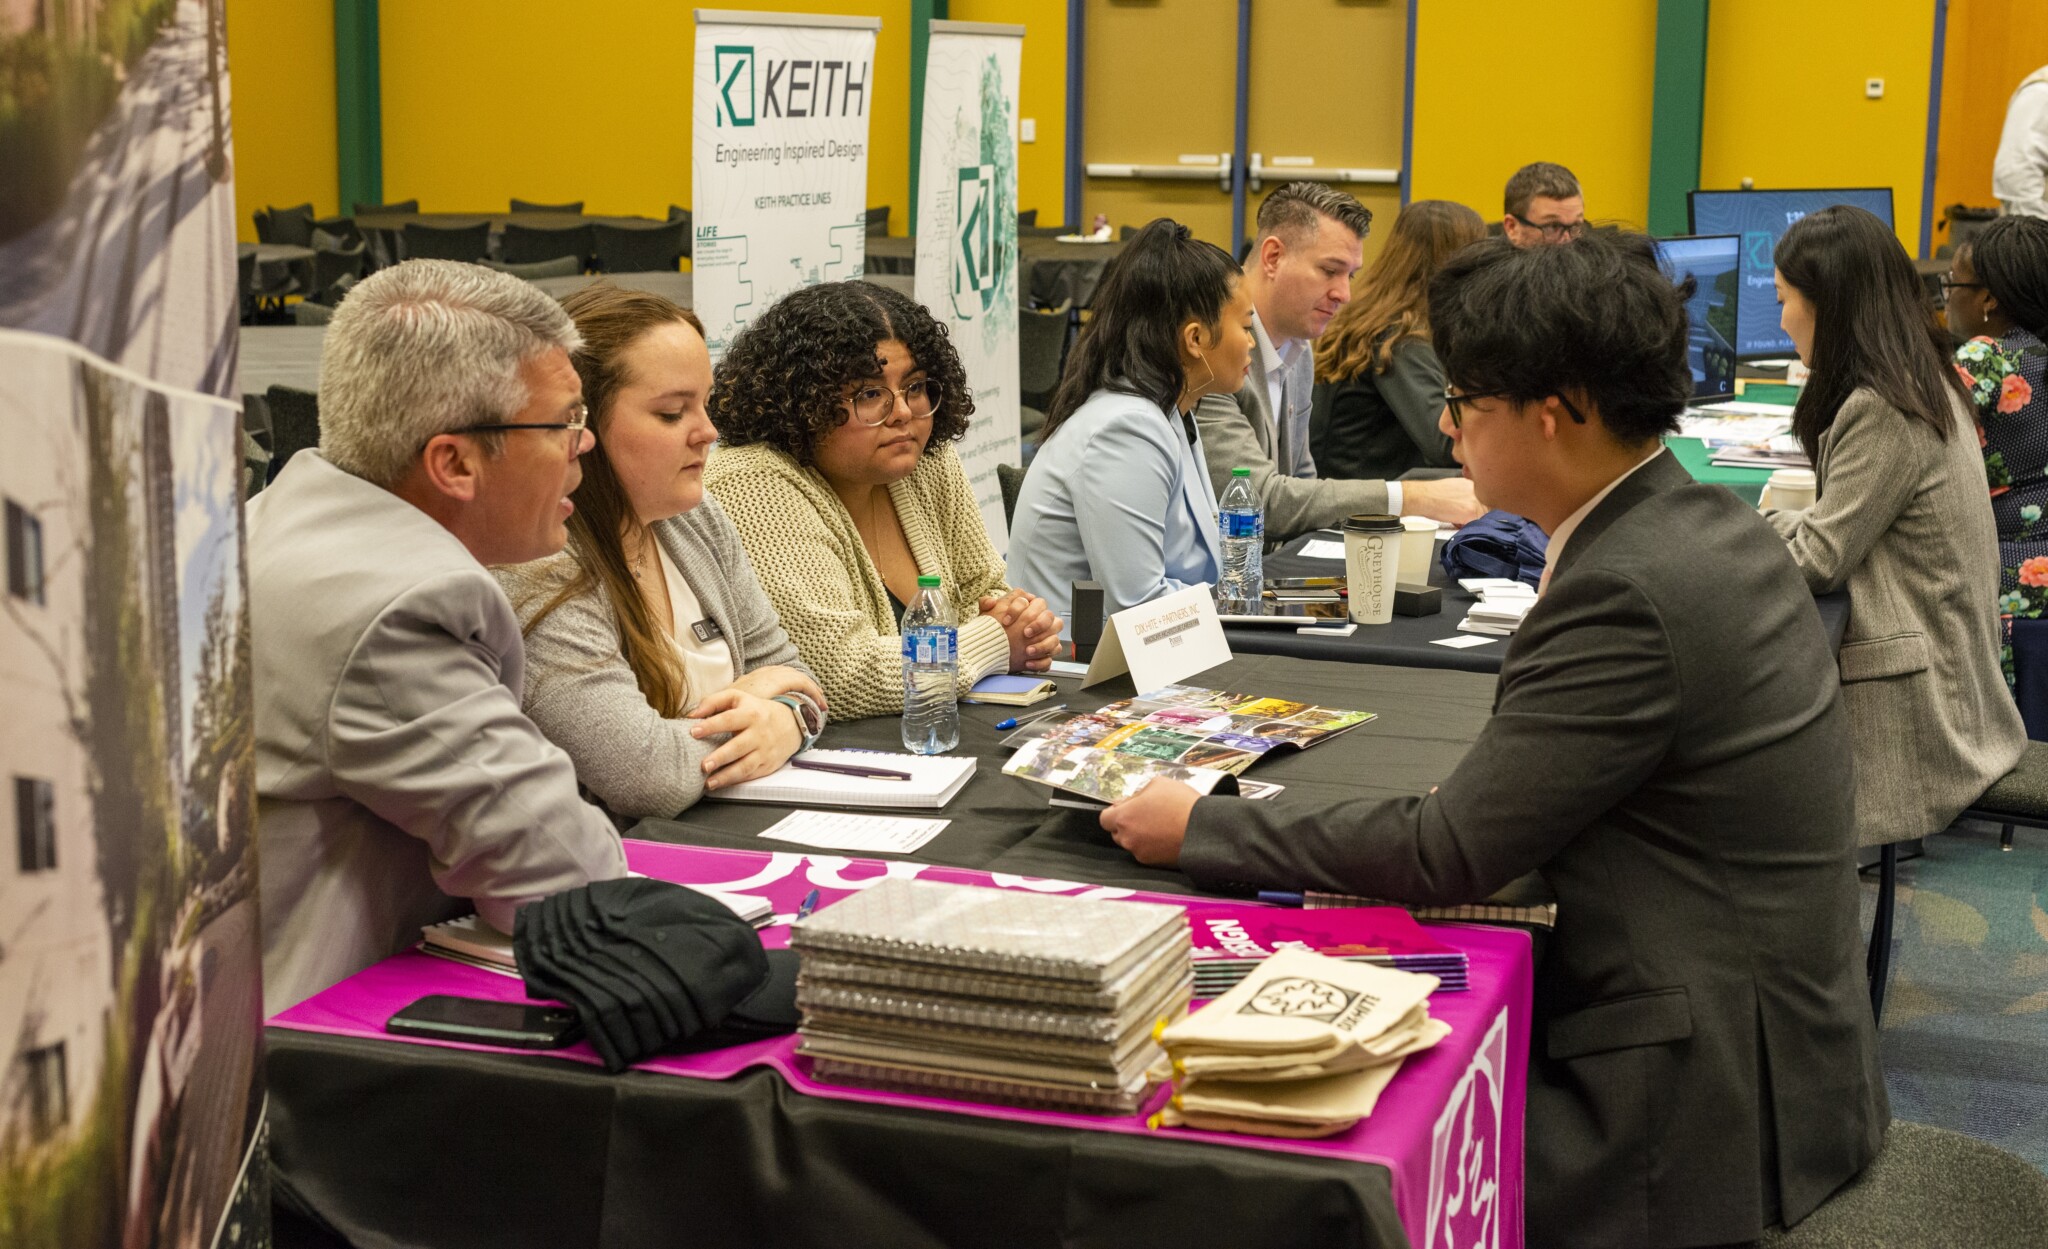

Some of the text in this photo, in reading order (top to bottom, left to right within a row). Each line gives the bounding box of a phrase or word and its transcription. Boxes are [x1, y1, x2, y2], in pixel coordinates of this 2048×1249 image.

[763, 60, 867, 118] KEITH
[716, 143, 781, 168] Engineering
[783, 140, 826, 164] Inspired
[754, 191, 832, 209] KEITH PRACTICE LINES
[696, 226, 718, 238] LIFE
[1367, 535, 1384, 617] GREYHOUSE
